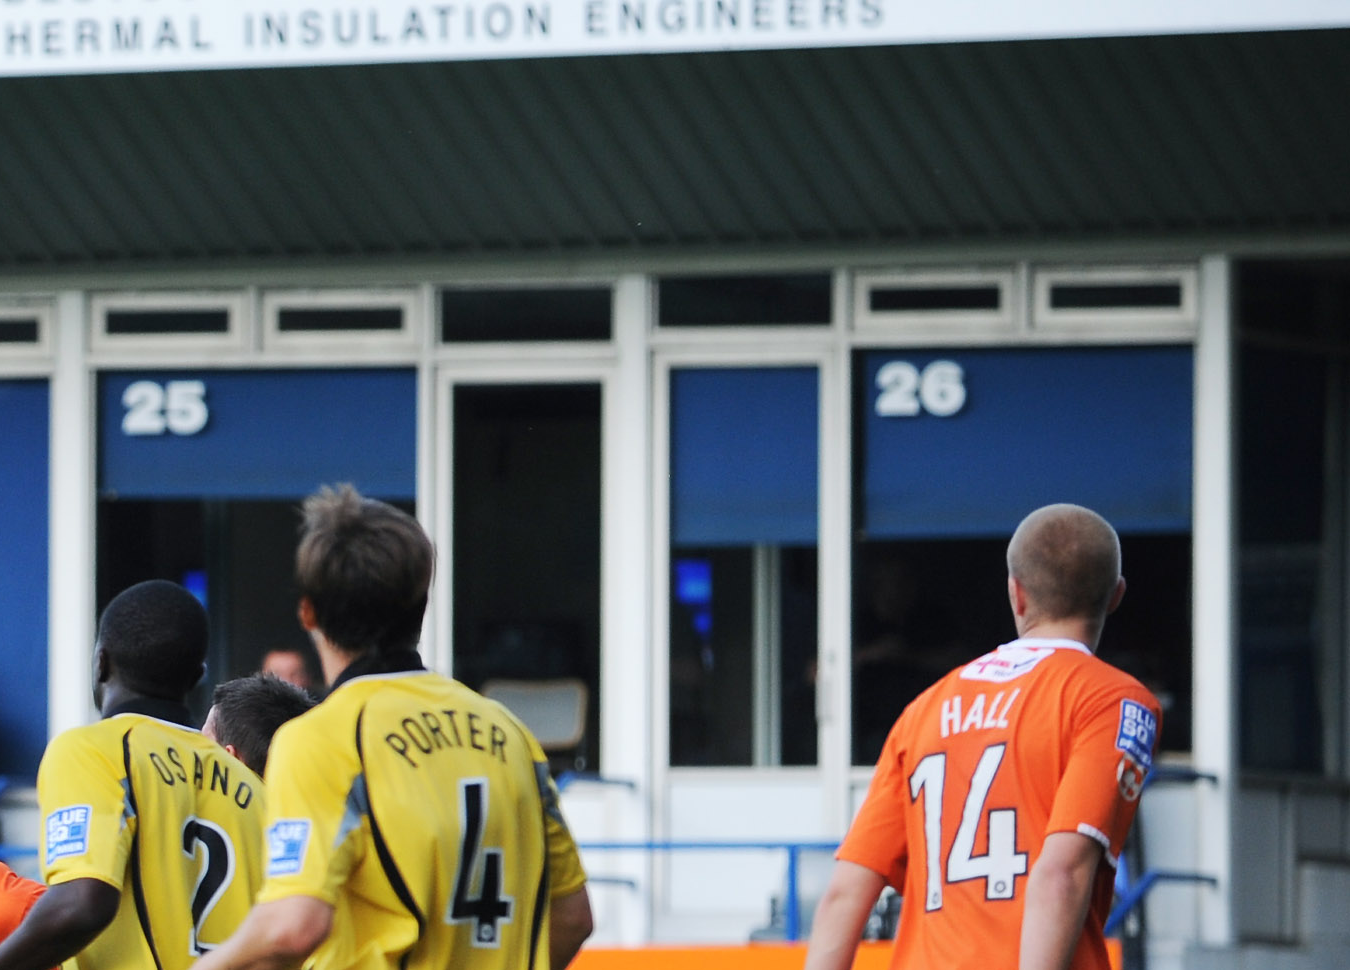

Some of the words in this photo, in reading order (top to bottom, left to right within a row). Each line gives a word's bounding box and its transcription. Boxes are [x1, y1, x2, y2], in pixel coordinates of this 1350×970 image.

[244, 7, 549, 48] INSULATION
[585, 0, 883, 35] ENGINEERS
[121, 380, 209, 436] 25
[874, 360, 966, 417] 26
[385, 708, 508, 769] PORTER
[940, 687, 1021, 738] HALL
[149, 747, 253, 811] OSANO
[909, 742, 1028, 912] 14
[181, 815, 235, 956] 2
[446, 777, 513, 949] 4
